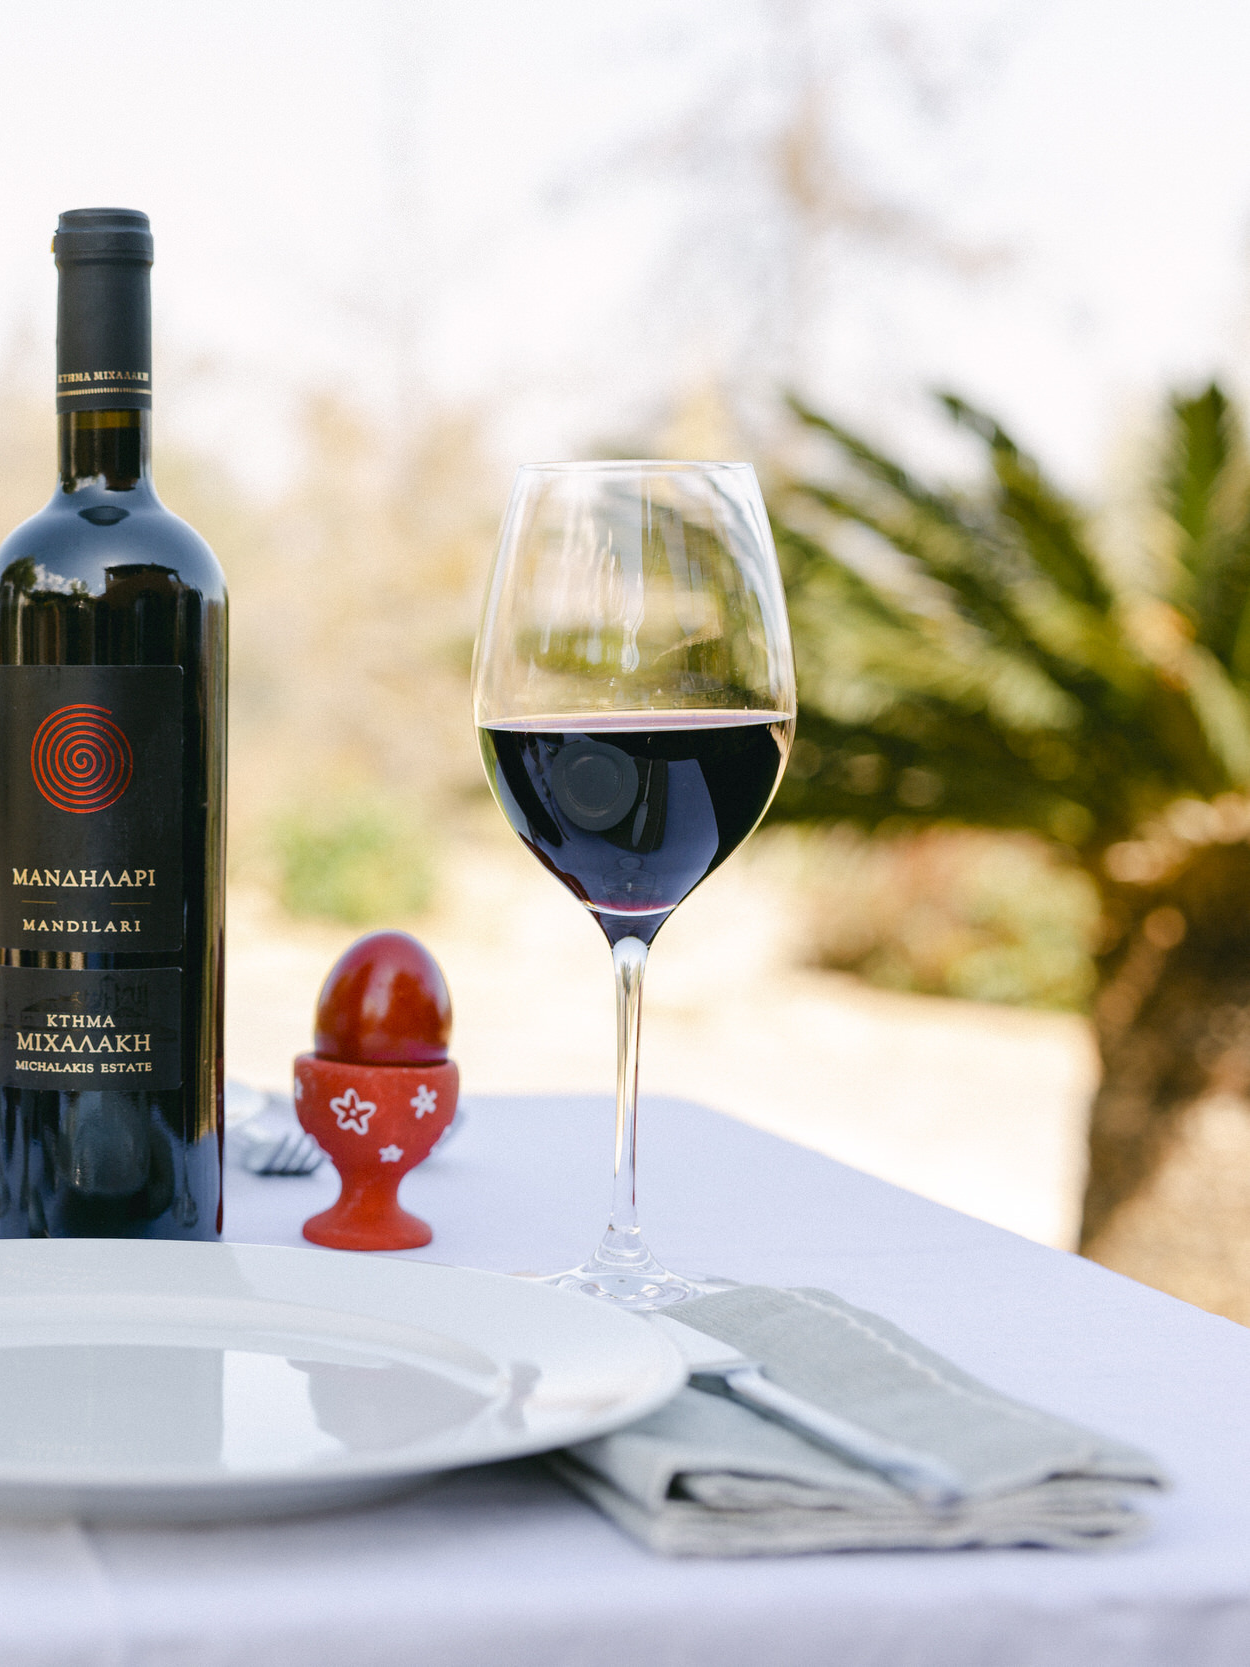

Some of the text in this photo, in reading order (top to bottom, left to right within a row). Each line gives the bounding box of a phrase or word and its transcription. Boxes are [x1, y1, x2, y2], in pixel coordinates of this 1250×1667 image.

[12, 867, 156, 888] ΜΑΝΔΗΛΑΡΙ
[22, 918, 141, 933] MANDILARI
[46, 1013, 116, 1028] ΚΤΗΜΑ
[16, 1031, 152, 1053] ΜΙΧΑΛΑΚΗ
[15, 1059, 153, 1074] MICHALAKIS ESTATE
